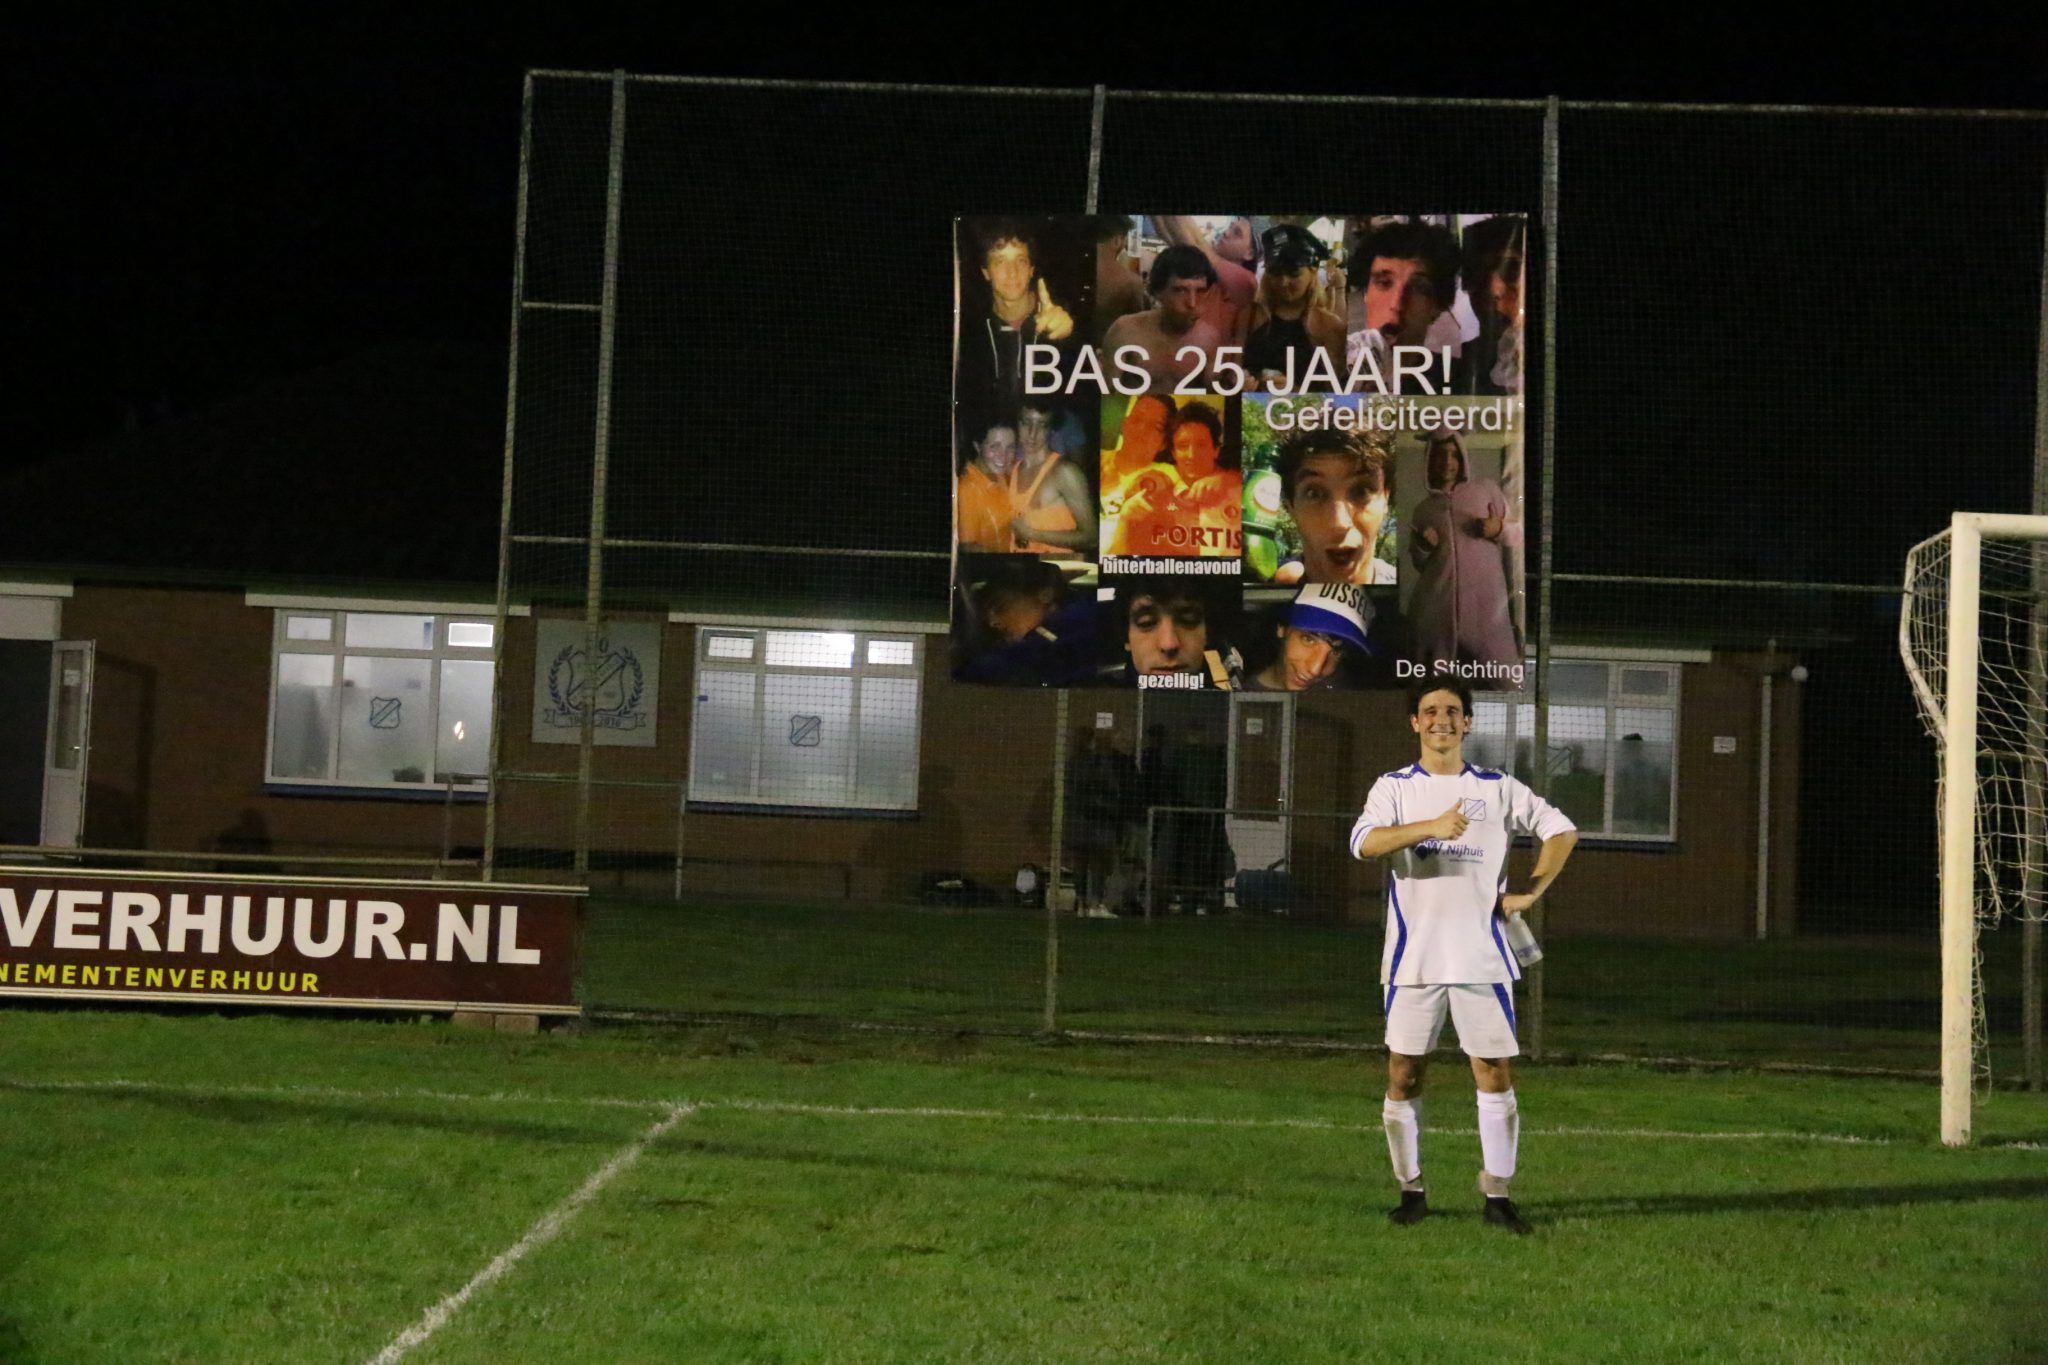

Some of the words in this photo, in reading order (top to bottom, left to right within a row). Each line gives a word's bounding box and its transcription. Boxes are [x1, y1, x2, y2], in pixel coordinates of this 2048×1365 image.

[1024, 344, 1152, 396] BAS
[1174, 344, 1245, 396] 25
[1266, 345, 1452, 396] JAAR!
[1265, 397, 1515, 431] Gefeliciteerd!
[1102, 557, 1242, 575] bitterballenavond
[1137, 673, 1205, 690] gezellig!
[1396, 659, 1427, 678] De
[1433, 659, 1524, 684] Stichting
[0, 888, 541, 965] VERHUUR.NL
